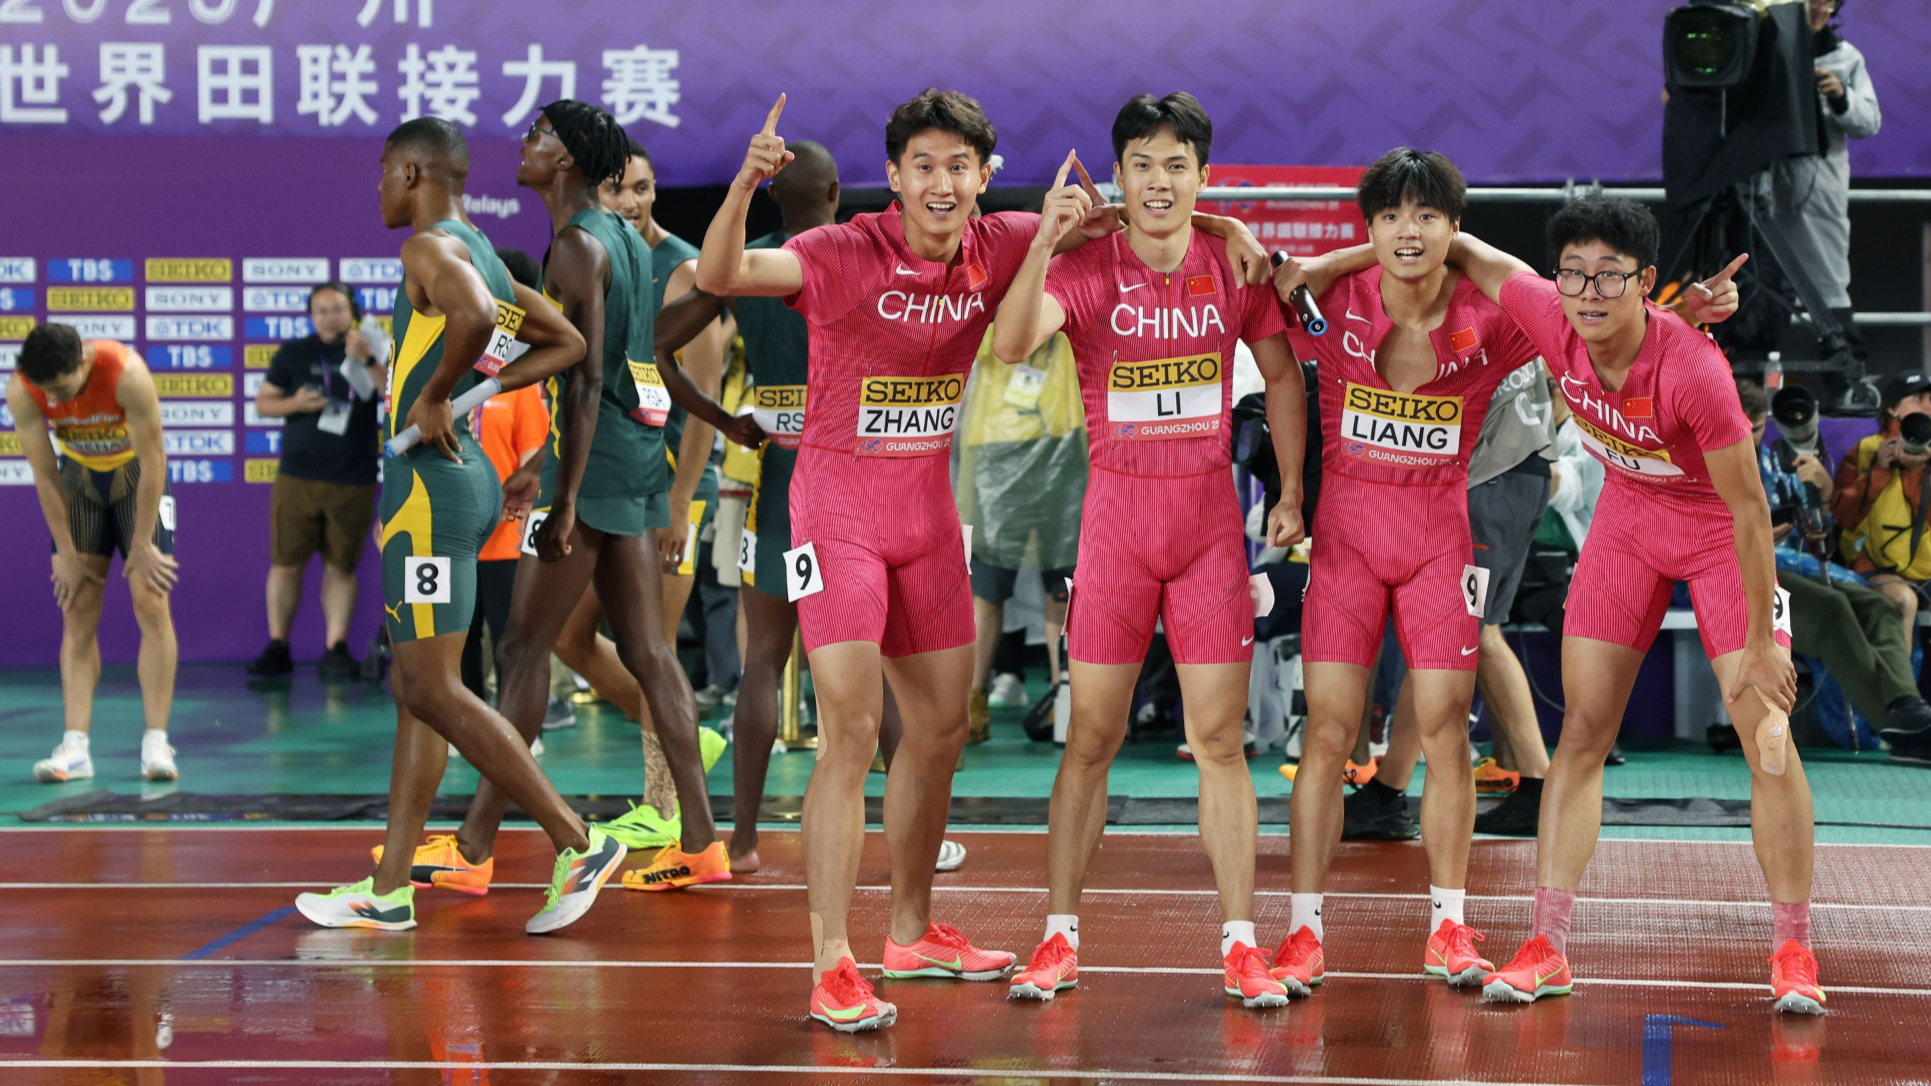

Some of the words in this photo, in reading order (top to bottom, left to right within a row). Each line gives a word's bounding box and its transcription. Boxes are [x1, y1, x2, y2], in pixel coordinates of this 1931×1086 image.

[0, 43, 680, 127] 世界田联接力赛
[68, 258, 113, 281] TBS
[150, 262, 226, 279] SEIKO
[252, 264, 316, 276] SONY
[51, 291, 129, 308] SEIKO
[155, 292, 219, 304] SONY
[877, 289, 985, 324] CHINA
[175, 321, 223, 333] TDK
[265, 316, 310, 338] TBS
[1110, 303, 1225, 339] CHINA
[168, 345, 212, 368] TBS
[1112, 358, 1218, 388] SEIKO
[865, 378, 961, 403] SEIKO
[1157, 391, 1181, 416] LI
[1349, 387, 1459, 421] SEIKO
[1560, 374, 1664, 444] CHINA
[776, 412, 805, 432] RS
[864, 406, 955, 433] ZHANG
[1141, 421, 1209, 436] GUANGZHOU
[1211, 420, 1220, 430] 25
[175, 436, 223, 449] TDK
[1352, 414, 1448, 450] LIANG
[886, 440, 943, 452] GUANGZHOU
[1368, 449, 1437, 466] GUANGZHOU
[1605, 446, 1641, 470] FU
[168, 460, 212, 482] TBS
[741, 536, 749, 565] 8
[415, 562, 439, 596] 8
[796, 553, 812, 590] 9
[1467, 573, 1478, 607] 9
[643, 865, 690, 884] NITRO
